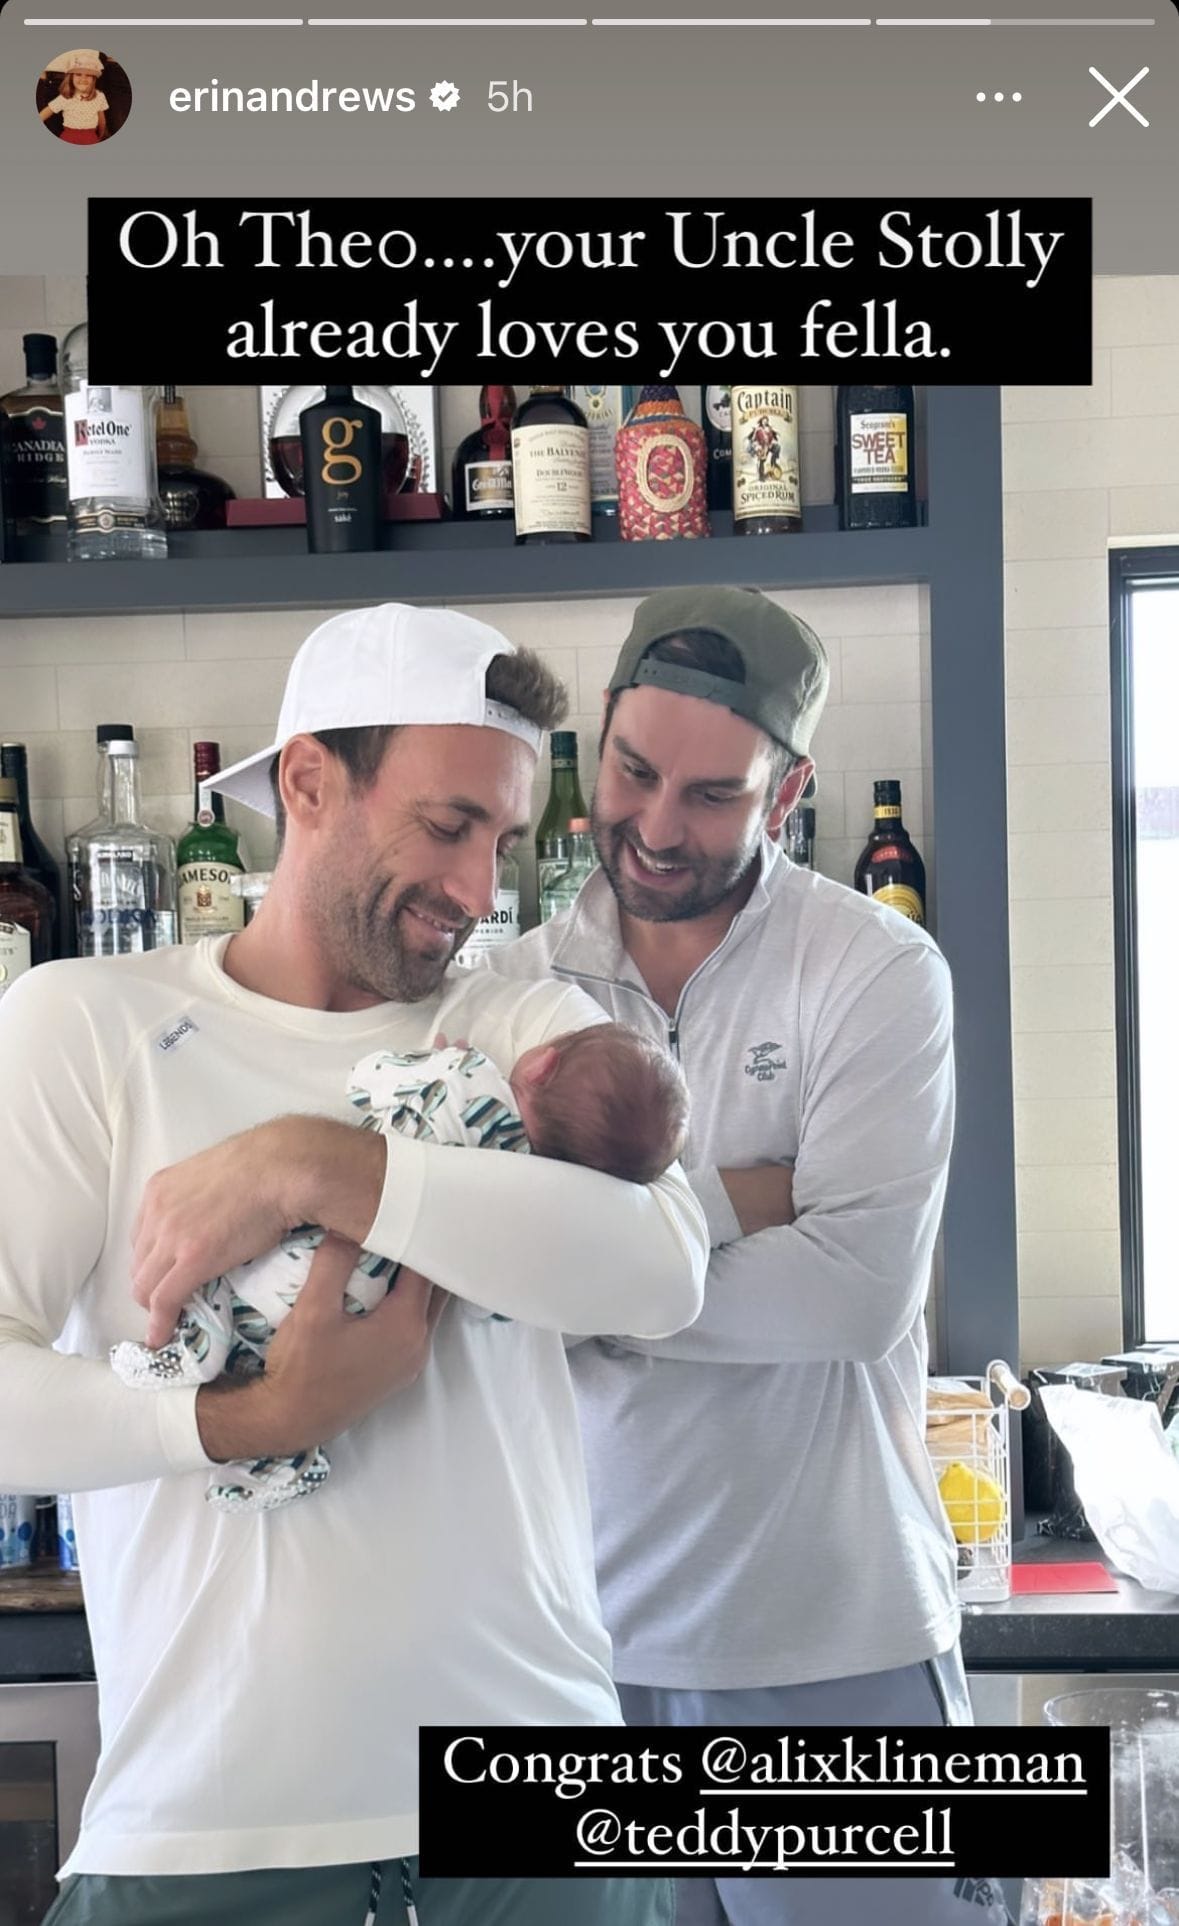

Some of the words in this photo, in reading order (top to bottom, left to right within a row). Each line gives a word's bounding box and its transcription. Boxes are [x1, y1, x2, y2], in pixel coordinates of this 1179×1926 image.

[737, 389, 792, 417] Captain
[106, 420, 131, 437] One
[852, 431, 906, 450] SWEET
[862, 448, 896, 465] TEA
[556, 482, 568, 492] 12
[180, 867, 231, 887] AMESO
[480, 906, 513, 924] ARDÍ
